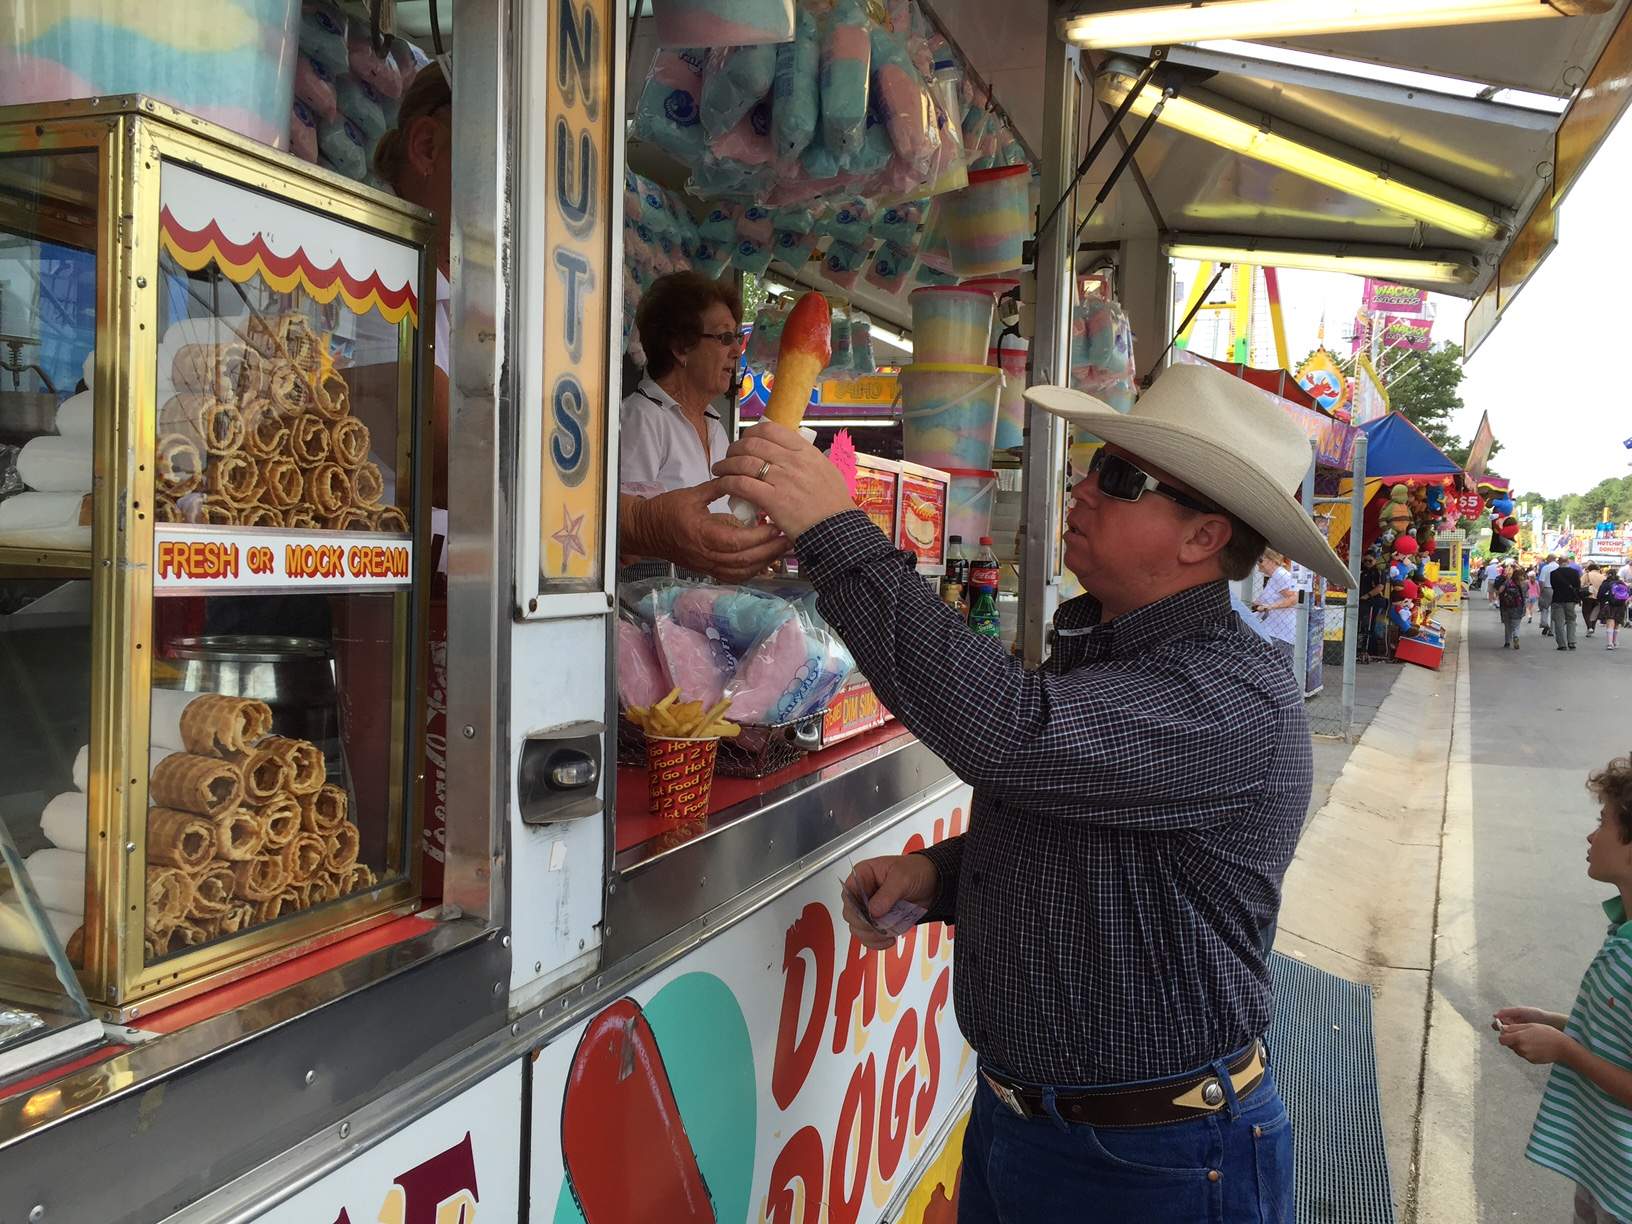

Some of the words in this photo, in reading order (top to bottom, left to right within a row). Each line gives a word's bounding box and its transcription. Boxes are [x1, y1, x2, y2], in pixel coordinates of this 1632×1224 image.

[549, 0, 598, 487] NUTS
[1374, 286, 1420, 298] WACKY
[158, 541, 240, 580] FRESH
[246, 546, 275, 575] OR
[284, 543, 345, 579] MOCK
[348, 545, 409, 578] CREAM
[654, 753, 684, 770] Food
[691, 748, 701, 760] 2
[662, 770, 681, 781] Go
[685, 758, 706, 775] Hot
[668, 774, 700, 794] Food
[663, 798, 673, 808] 2
[678, 791, 696, 804] Go
